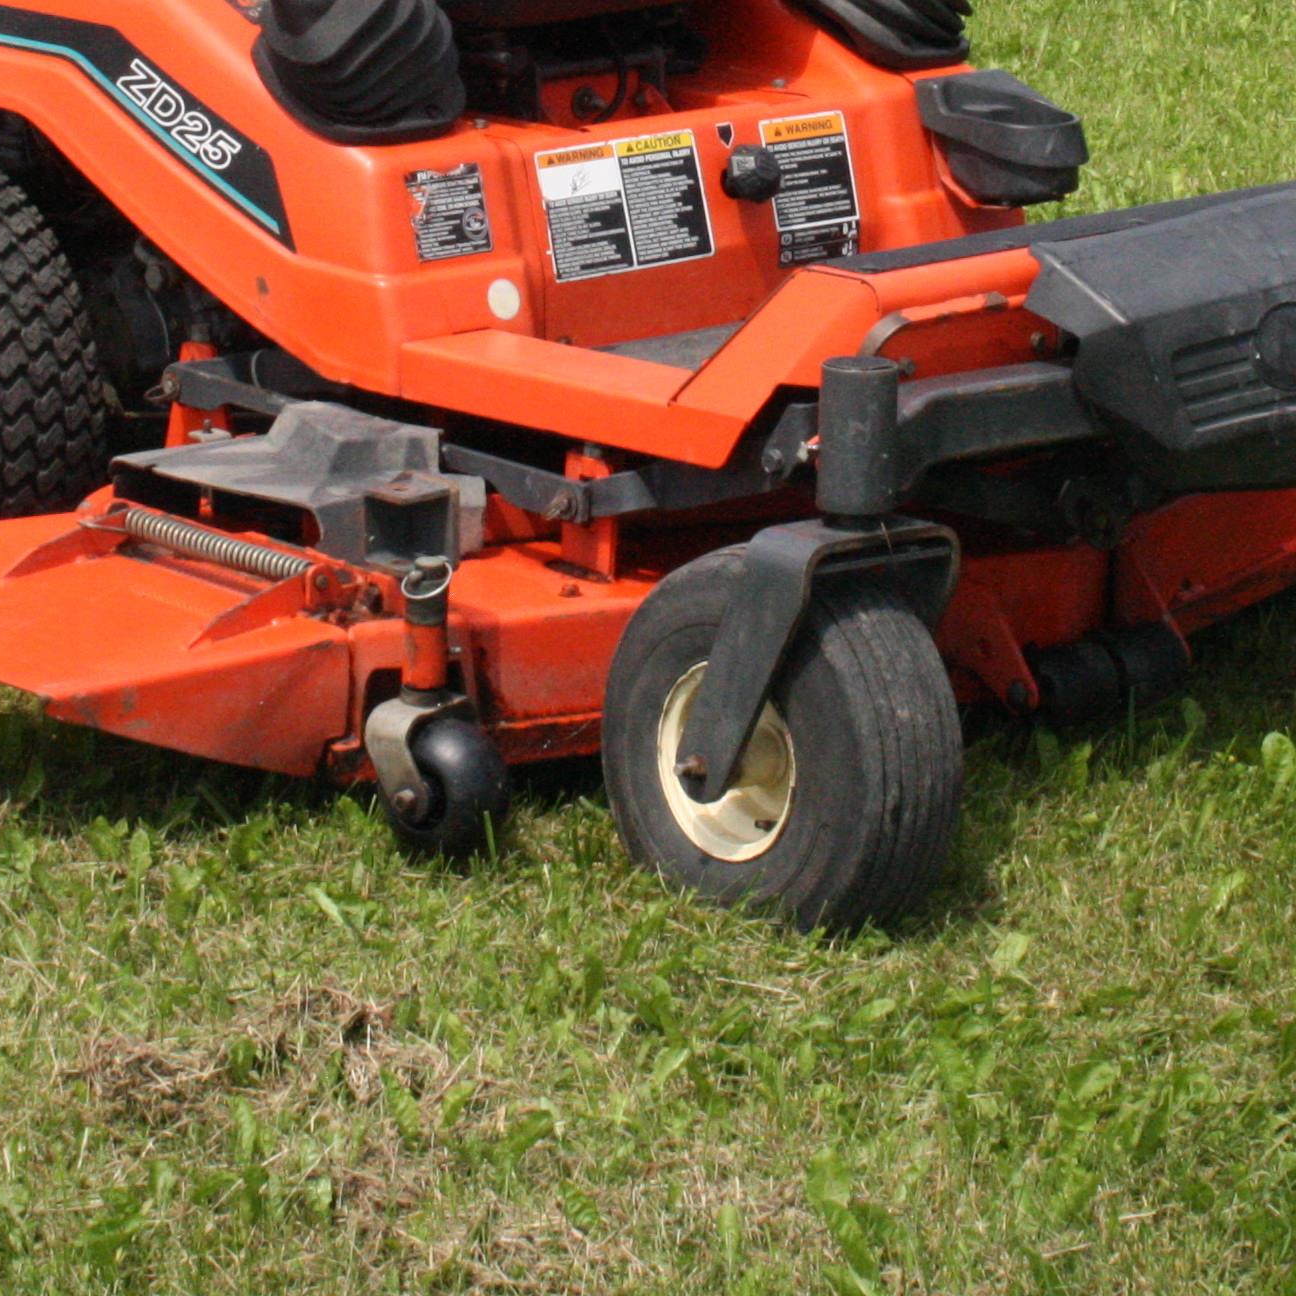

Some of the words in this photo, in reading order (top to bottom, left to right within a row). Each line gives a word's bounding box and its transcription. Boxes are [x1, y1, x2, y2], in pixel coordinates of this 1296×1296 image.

[116, 58, 242, 170] ZD25
[785, 120, 833, 134] WARNING
[635, 135, 682, 152] CAUTION
[555, 145, 605, 163] WARNING
